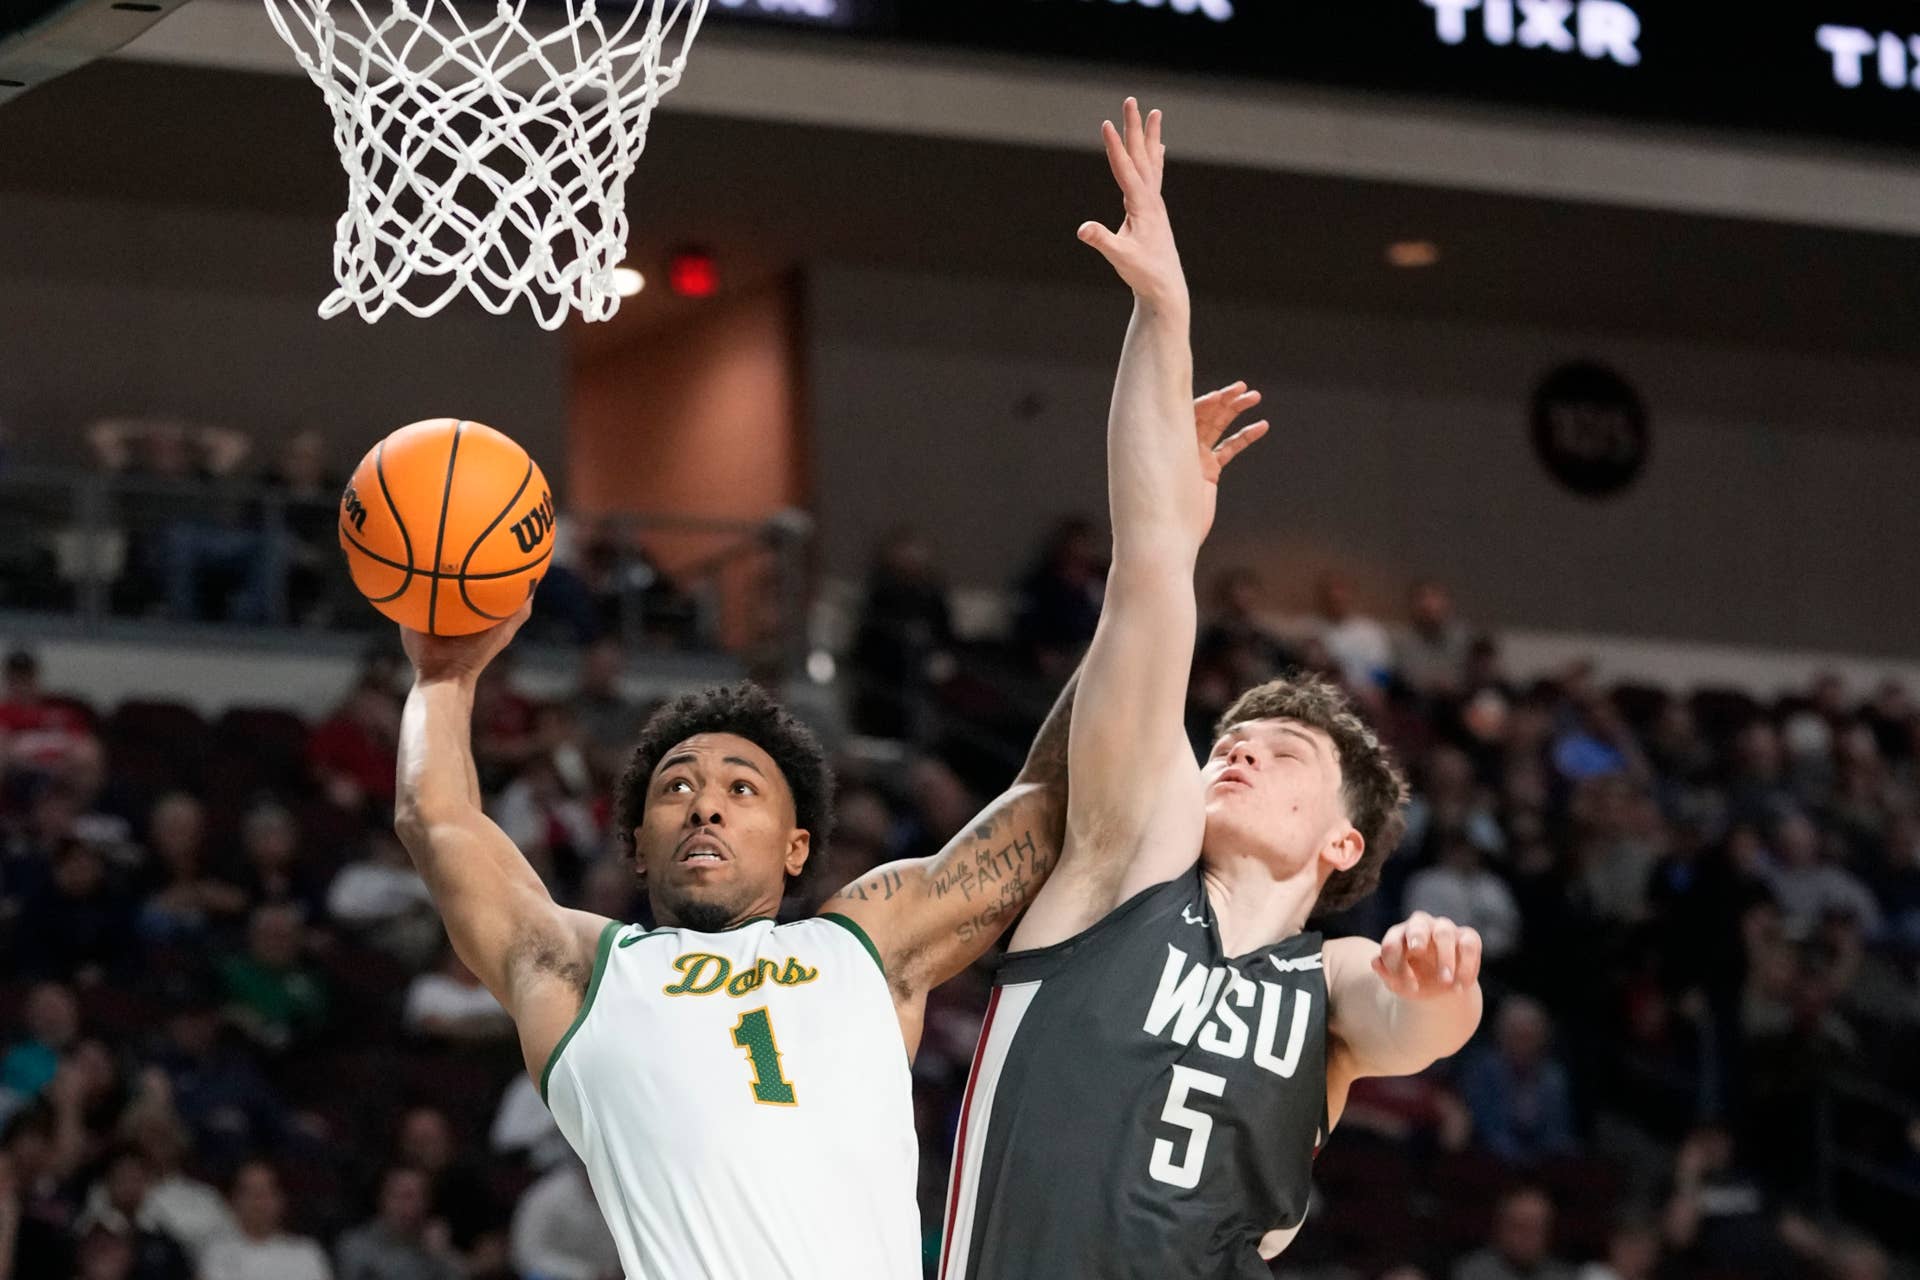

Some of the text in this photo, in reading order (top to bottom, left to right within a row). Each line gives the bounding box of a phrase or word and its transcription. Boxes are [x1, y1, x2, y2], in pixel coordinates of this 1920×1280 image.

[1419, 0, 1642, 66] TIXR
[1815, 24, 1920, 91] TI
[959, 830, 1037, 902] FAITH
[956, 878, 1031, 944] SIGHT
[662, 951, 819, 999] Dons
[1142, 942, 1312, 1079] WSU
[728, 1005, 799, 1107] 1
[1149, 1063, 1228, 1190] 5
